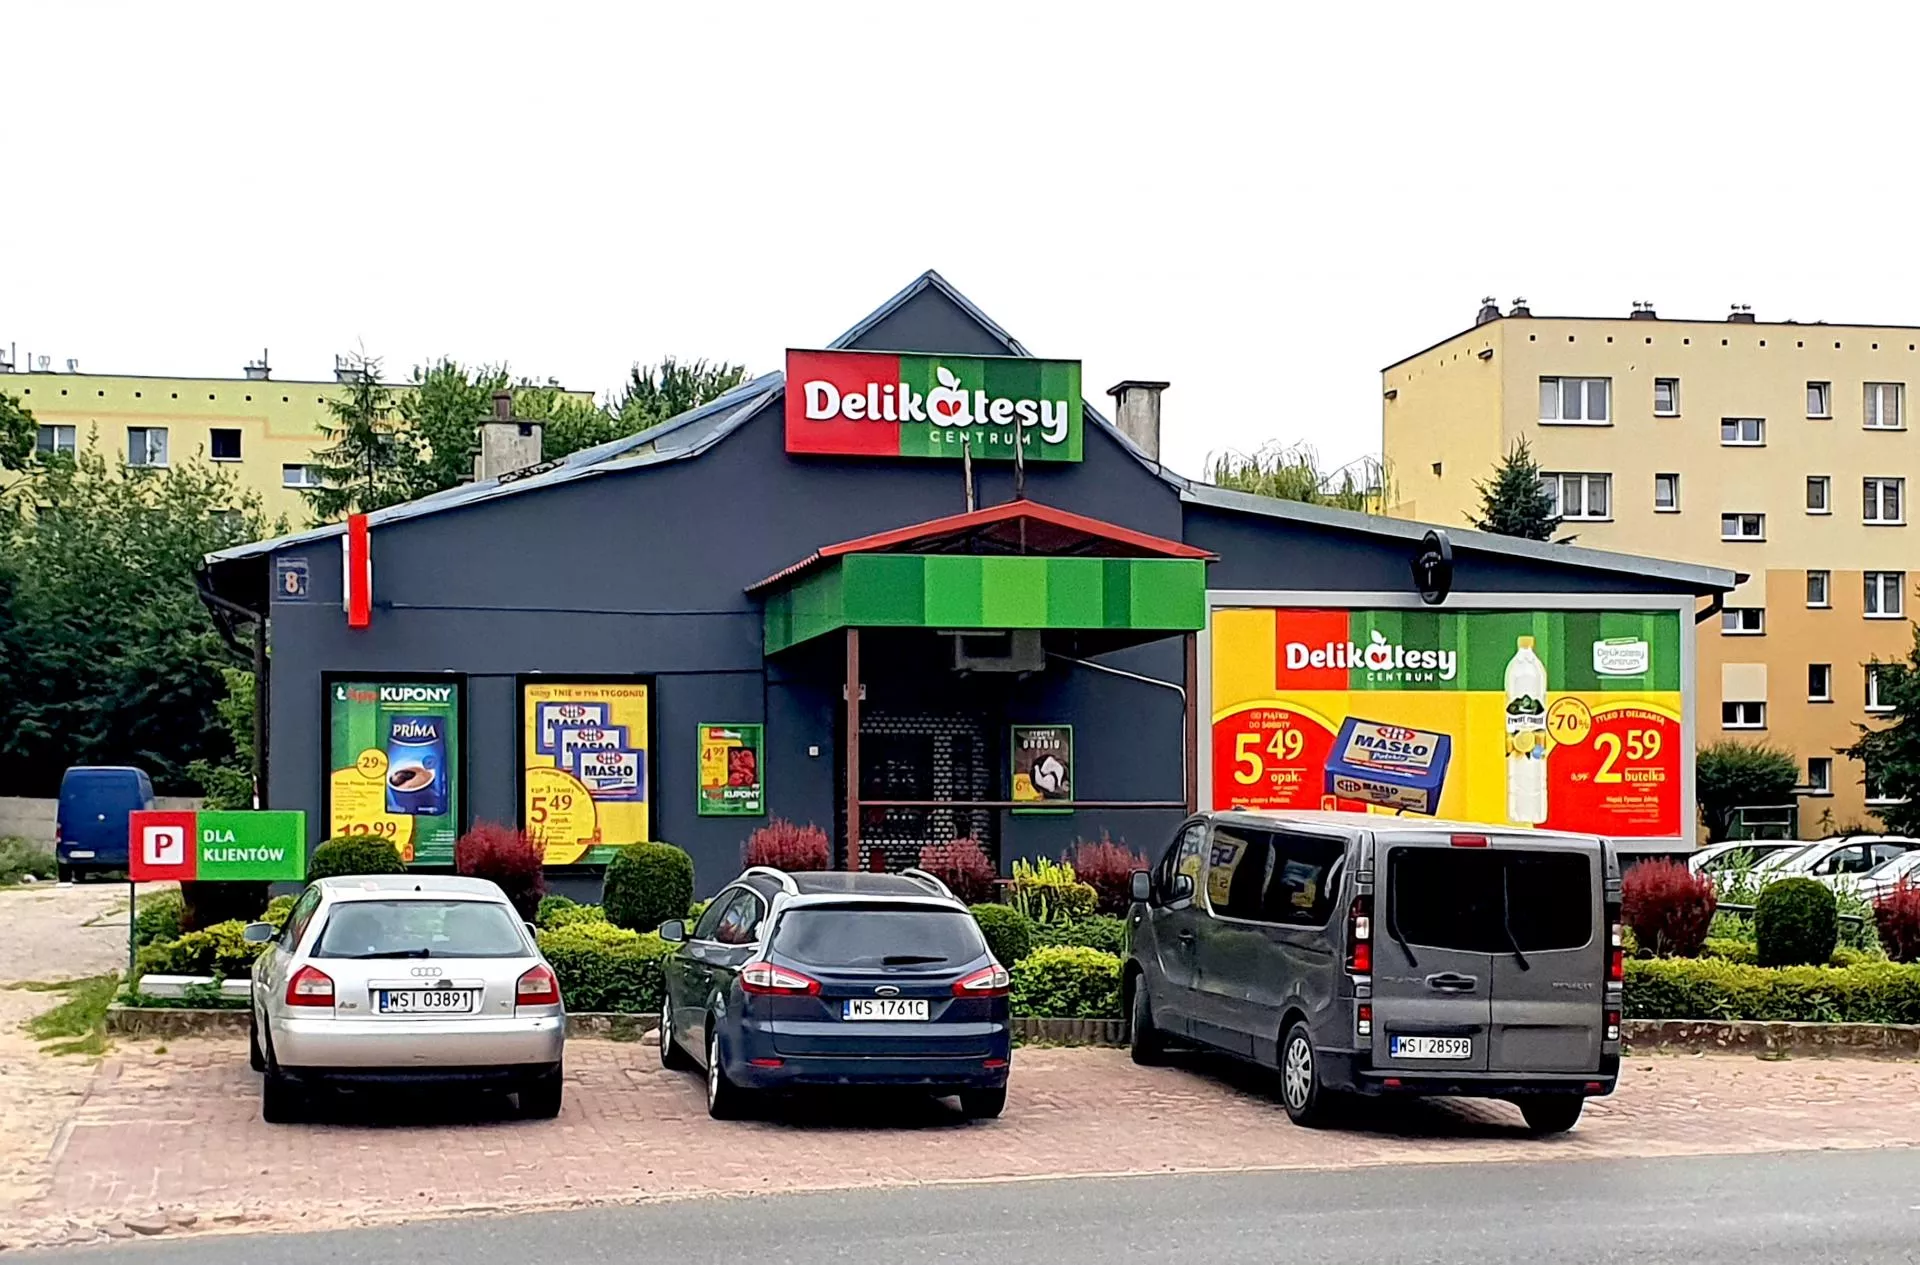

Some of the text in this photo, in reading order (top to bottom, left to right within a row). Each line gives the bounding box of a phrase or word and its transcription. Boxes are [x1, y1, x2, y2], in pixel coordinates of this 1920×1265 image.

[803, 366, 1068, 444] Delikatesy
[929, 430, 1032, 446] CENTRUM
[1286, 630, 1457, 680] Delikatesy
[1366, 672, 1434, 682] CENTRUM
[380, 687, 452, 702] KUPONY
[600, 689, 645, 698] TYGODNIU
[1249, 721, 1260, 729] DO
[1355, 734, 1428, 756] MASŁO
[1234, 729, 1304, 785] 5 49
[1594, 729, 1661, 783] 2 59
[584, 765, 633, 777] MASŁO
[1270, 769, 1302, 785] opak.
[1625, 768, 1665, 782] butelka
[724, 790, 760, 799] KUPONY
[1362, 782, 1399, 795] MASŁO
[531, 795, 572, 823] 5 49
[204, 830, 235, 843] DLA
[373, 821, 397, 838] 99
[155, 834, 173, 858] P
[204, 845, 284, 862] KLIENTÓW
[389, 992, 468, 1007] WSI 03891
[853, 1001, 924, 1015] WS 1761C
[1399, 1038, 1469, 1054] WSI 28598
